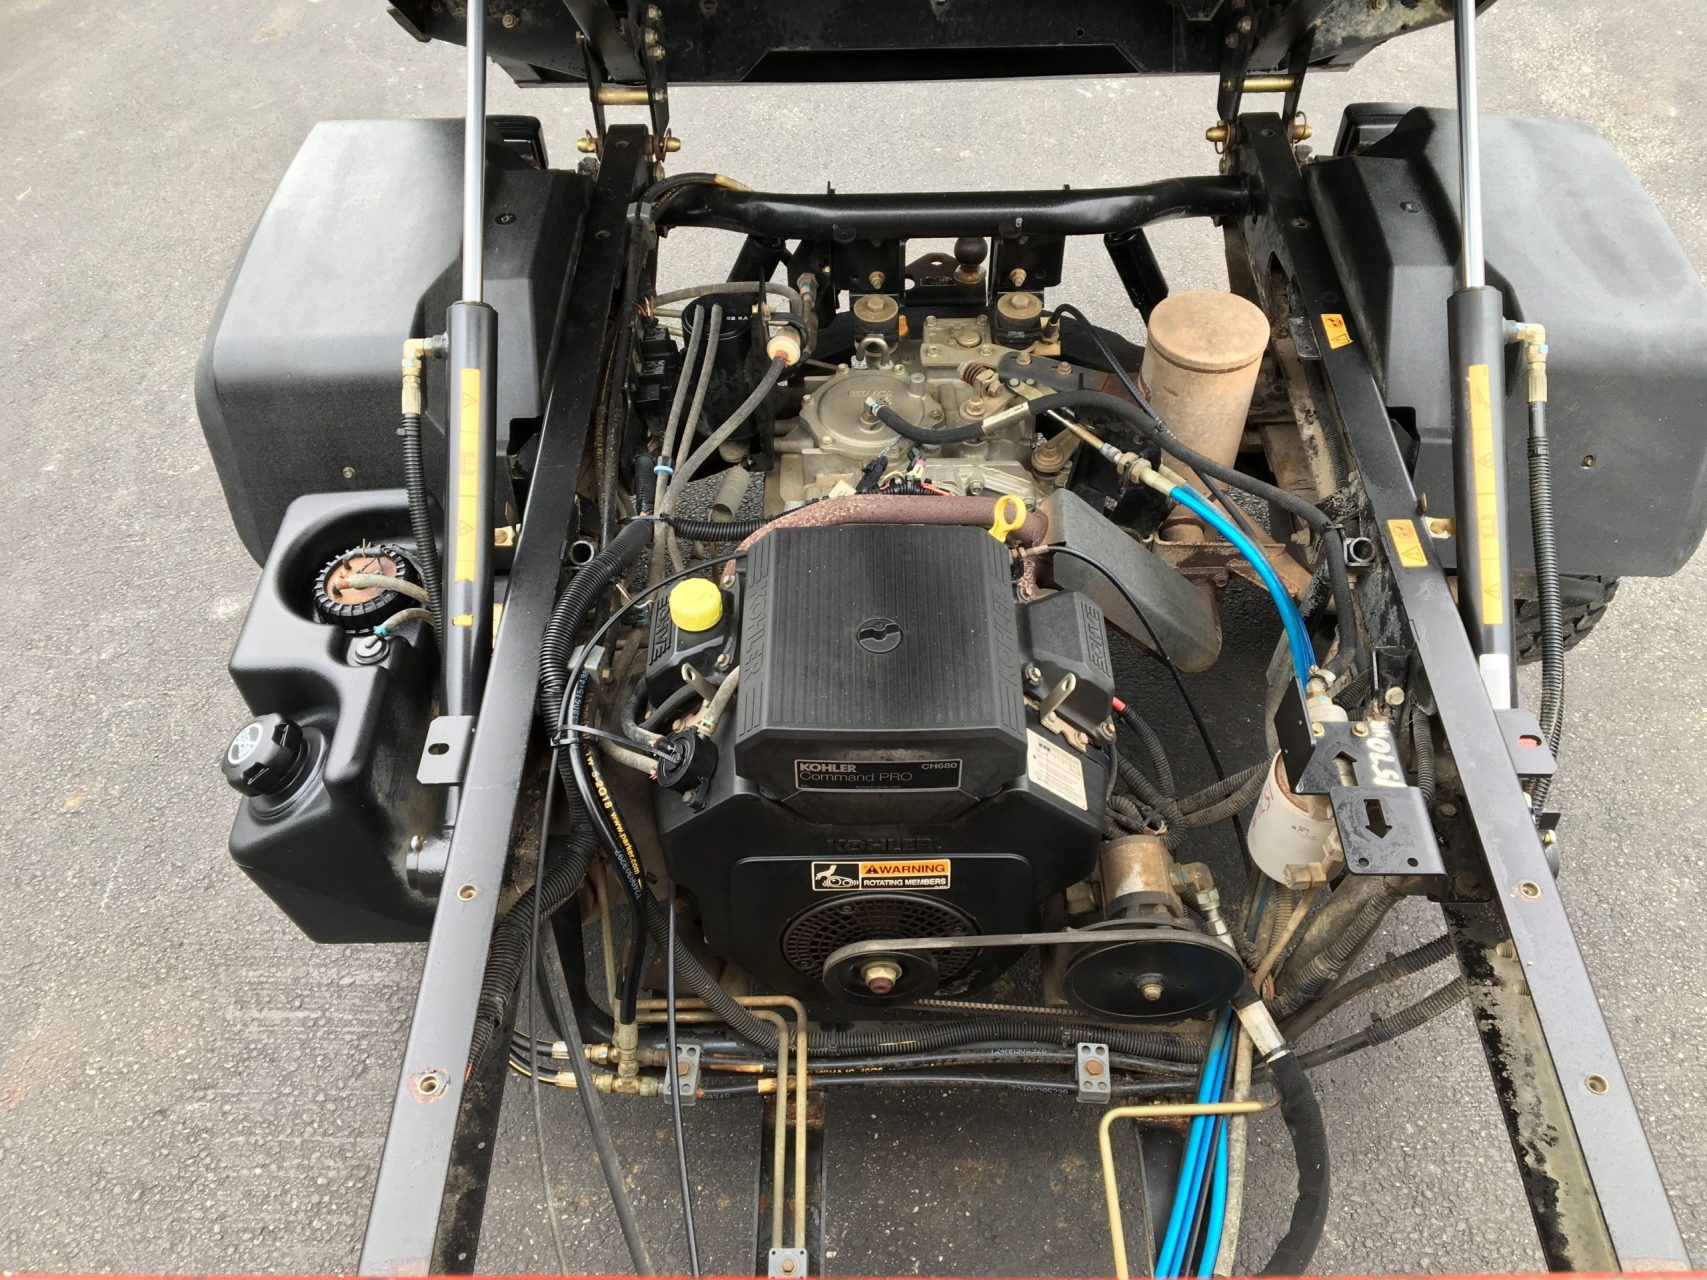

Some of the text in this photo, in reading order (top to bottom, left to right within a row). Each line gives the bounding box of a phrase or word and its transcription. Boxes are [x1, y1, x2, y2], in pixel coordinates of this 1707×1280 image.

[800, 762, 958, 773] KOHLER CH680
[1366, 737, 1408, 788] 1570
[800, 771, 913, 782] Command PRO
[610, 811, 641, 875] www.parker.com
[879, 863, 946, 874] WARNING
[863, 877, 947, 888] ROTATING MEMBERS
